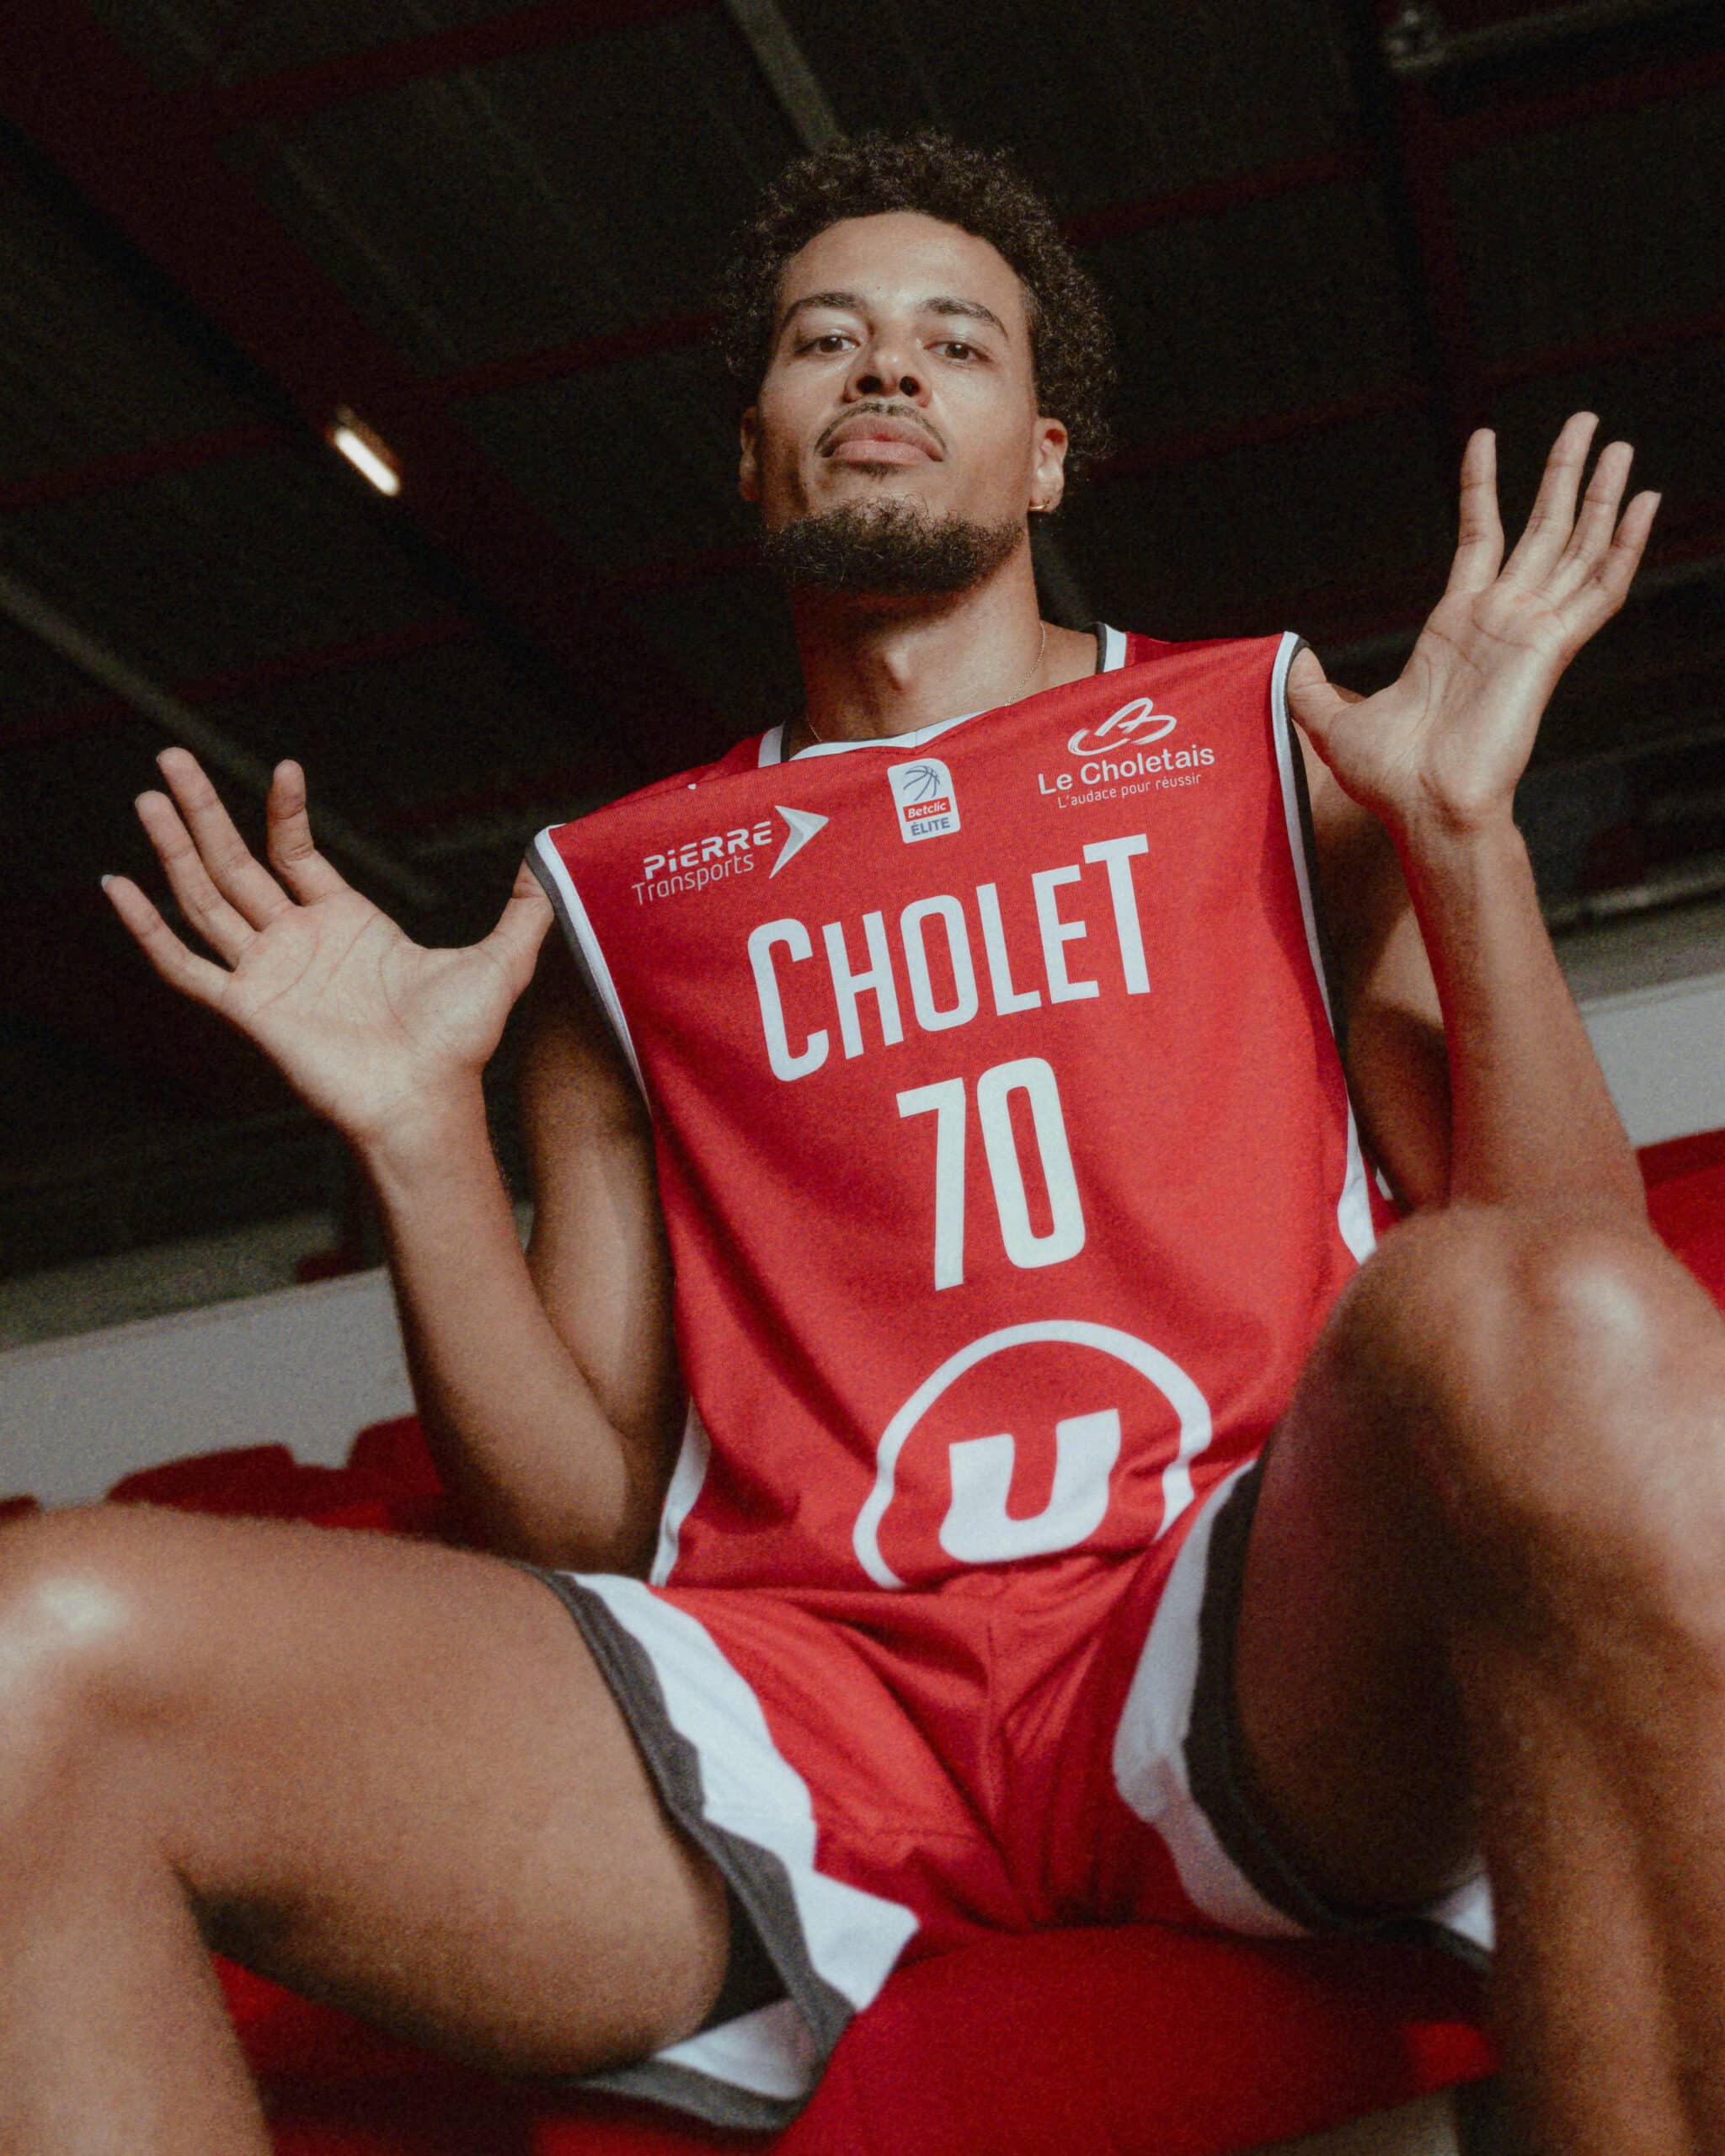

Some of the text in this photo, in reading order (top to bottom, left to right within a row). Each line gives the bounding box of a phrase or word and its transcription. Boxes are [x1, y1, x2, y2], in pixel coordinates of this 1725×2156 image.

[1038, 744, 1215, 796] Le Choletais
[1121, 781, 1151, 798] pour
[1156, 772, 1202, 789] réussir
[908, 802, 947, 819] Betclic
[632, 853, 755, 905] Transports
[747, 833, 1151, 1082] CHOLET
[895, 1057, 1087, 1291] 70
